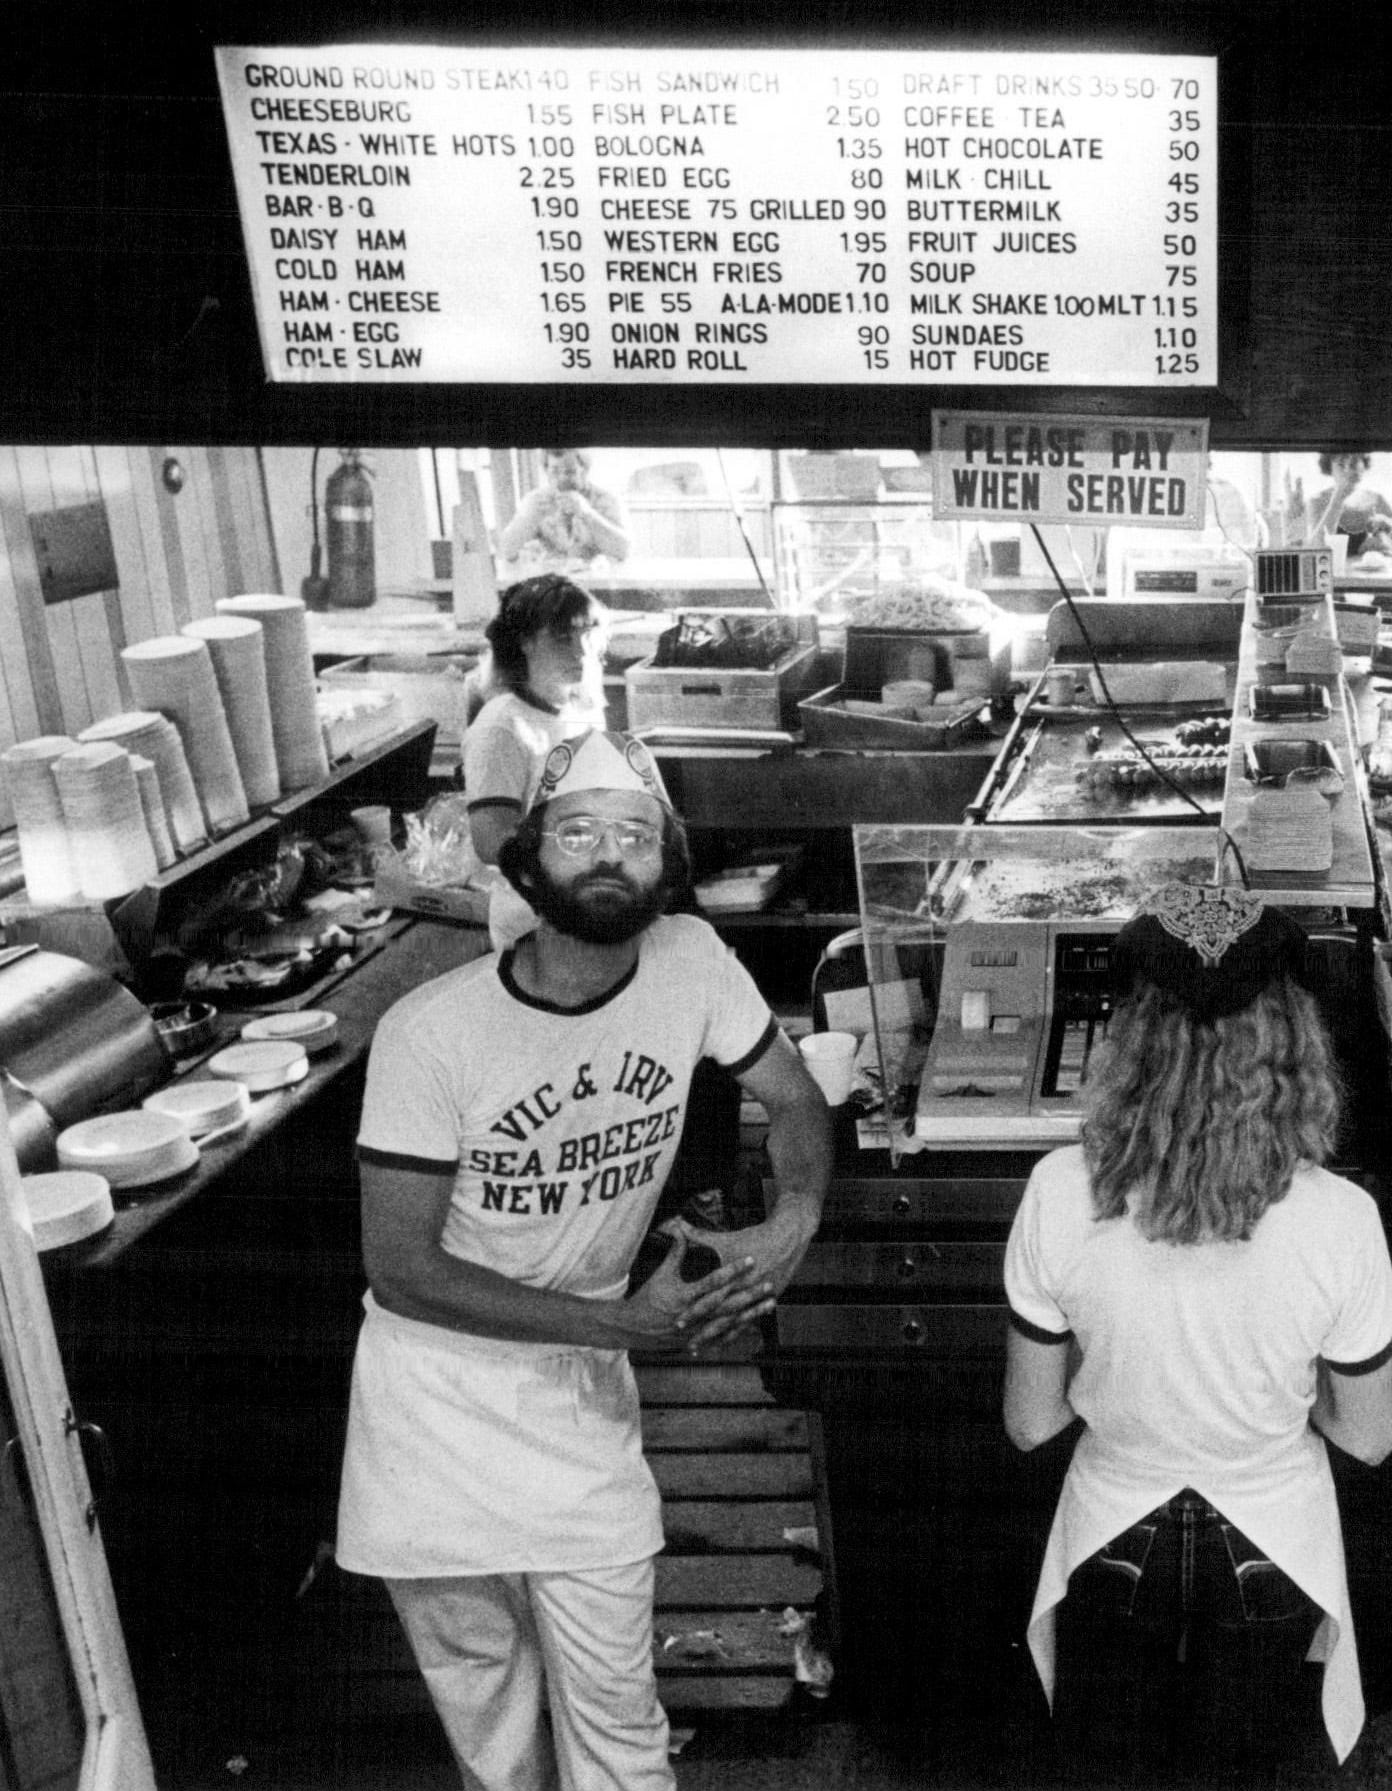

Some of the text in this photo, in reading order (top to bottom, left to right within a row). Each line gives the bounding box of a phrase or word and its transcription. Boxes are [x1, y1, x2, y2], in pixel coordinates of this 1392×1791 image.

[243, 62, 342, 91] GROUND
[353, 67, 434, 89] ROUND
[446, 69, 525, 90] STEAK
[589, 70, 642, 93] FISH
[658, 72, 778, 93] SANDWICH
[904, 74, 981, 95] DRAFT
[996, 74, 1081, 96] DRINKS
[1172, 79, 1199, 100] 70
[250, 96, 410, 122] CHEESEBURG
[593, 104, 645, 125] FISH
[661, 104, 737, 125] PLATE
[905, 106, 994, 128] COFFEE
[1019, 107, 1065, 128] TEA
[453, 135, 516, 156] HOTS
[595, 136, 704, 157] BOLOGNA
[905, 137, 1200, 161] HOT CHOCOLATE 50
[260, 162, 410, 186] TENDERLOIN
[598, 167, 883, 189] FRIED EGG 80
[1168, 172, 1199, 194] 45
[601, 199, 886, 220] CHEESE 75 GRILLED 90
[908, 200, 1061, 221] BUTTERMILK
[270, 228, 338, 250] DAISY
[357, 229, 406, 251] HAM
[604, 230, 718, 253] WESTERN
[733, 232, 779, 253] EGG
[909, 231, 1196, 256] FRUIT JUICES 50
[275, 258, 337, 280] COLD
[355, 259, 405, 281] HAM
[606, 261, 886, 283] FRENCH FRIES 70
[910, 261, 1197, 287] SOUP 75
[609, 292, 644, 313] PIE
[661, 292, 692, 313] 55
[973, 293, 1047, 315] SHAKE
[1098, 295, 1146, 316] MLT
[612, 323, 890, 346] ONION RINGS 90
[912, 324, 1023, 346] SUNDAES
[285, 347, 347, 368] COLE
[357, 347, 422, 369] SLAW
[613, 348, 889, 371] HARD ROLL 15
[910, 350, 957, 371] HOT
[974, 350, 1049, 372] FUDGE
[965, 425, 1174, 471] PLEASE PAY
[953, 469, 1186, 516] WHEN SERVED
[490, 1051, 674, 1142] VIC & IRV
[469, 1104, 680, 1178] SEA BREEZE
[481, 1151, 662, 1215] NEW YORK
